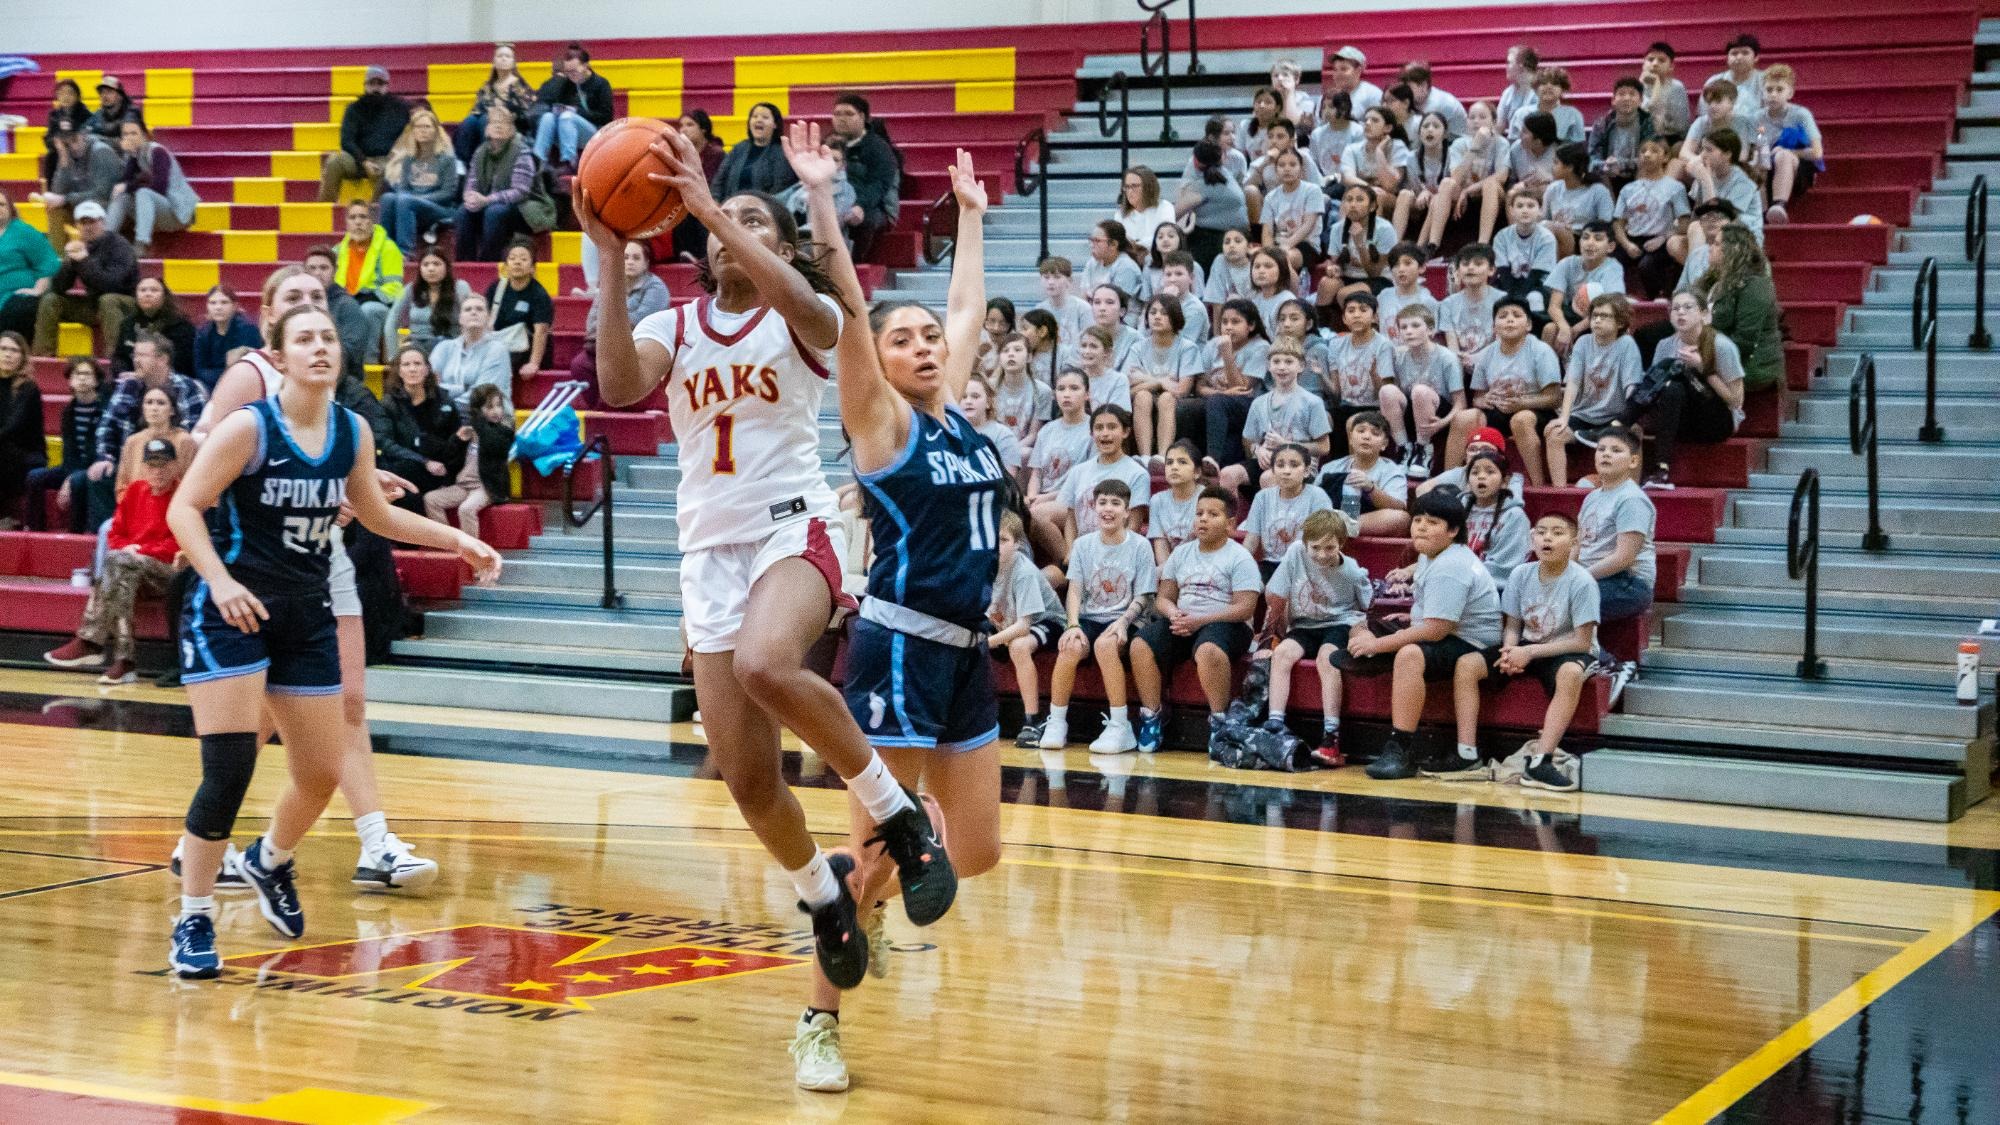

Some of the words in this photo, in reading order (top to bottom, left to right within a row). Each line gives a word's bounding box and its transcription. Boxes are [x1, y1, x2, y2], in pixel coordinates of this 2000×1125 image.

[683, 364, 780, 412] YAKS
[712, 413, 736, 476] 1
[282, 516, 331, 554] 24
[969, 490, 996, 550] 11
